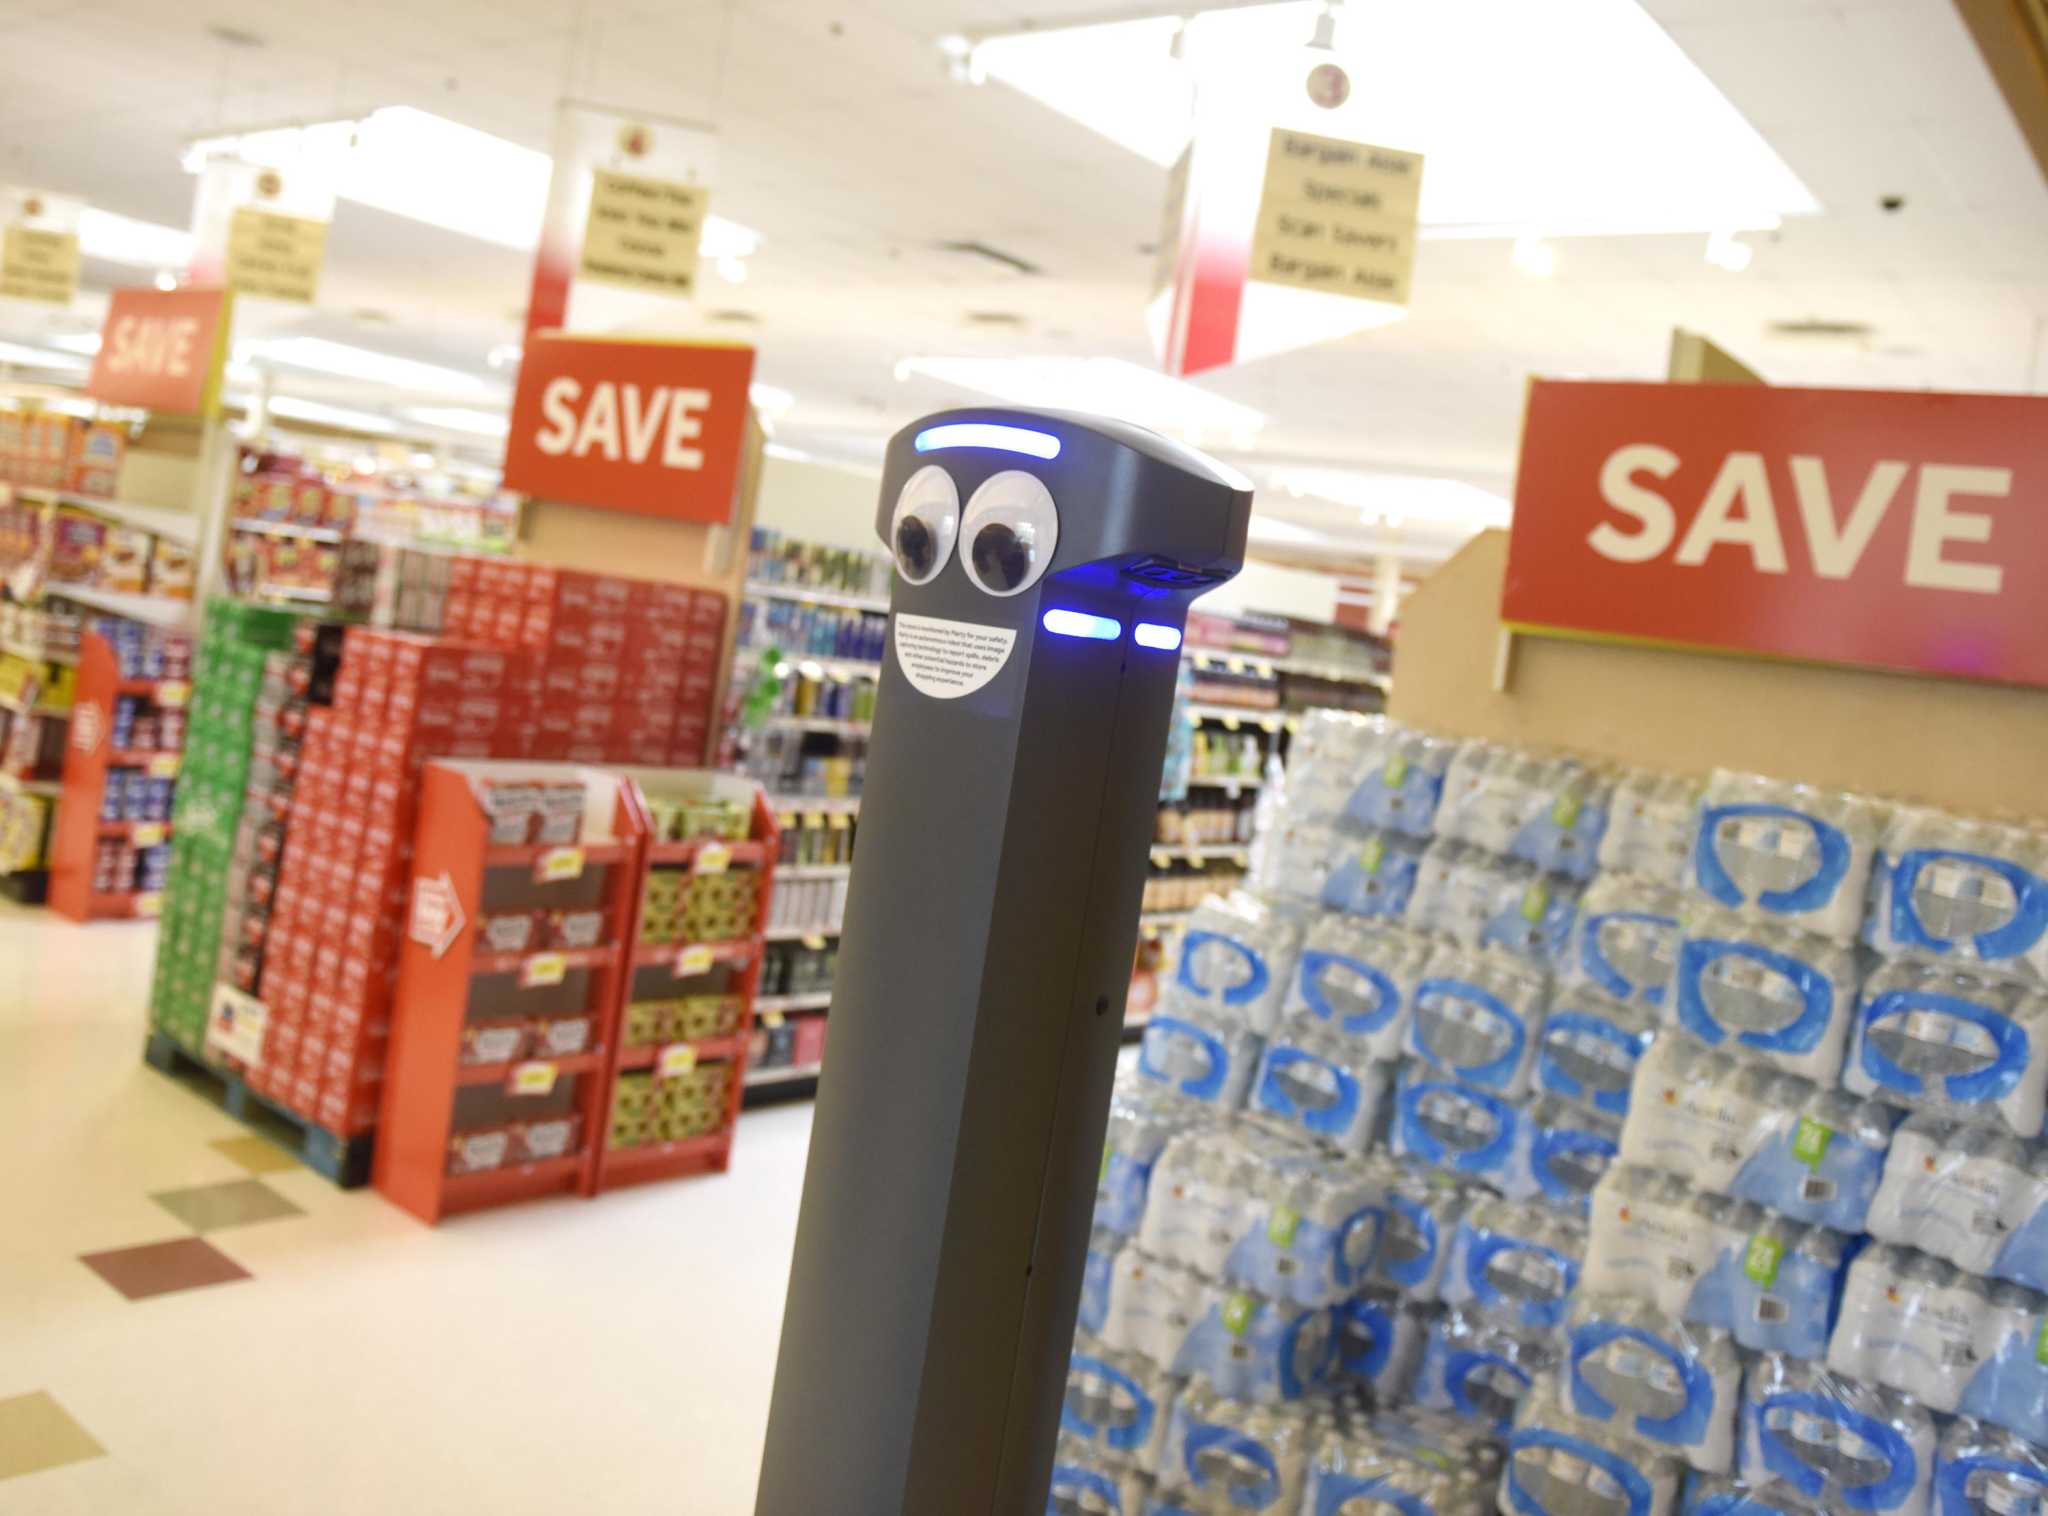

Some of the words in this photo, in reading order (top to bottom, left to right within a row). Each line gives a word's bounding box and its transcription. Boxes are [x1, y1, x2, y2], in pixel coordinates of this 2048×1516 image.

[106, 316, 198, 377] SAVE
[535, 376, 710, 471] SAVE
[1586, 443, 2013, 594] SAVE
